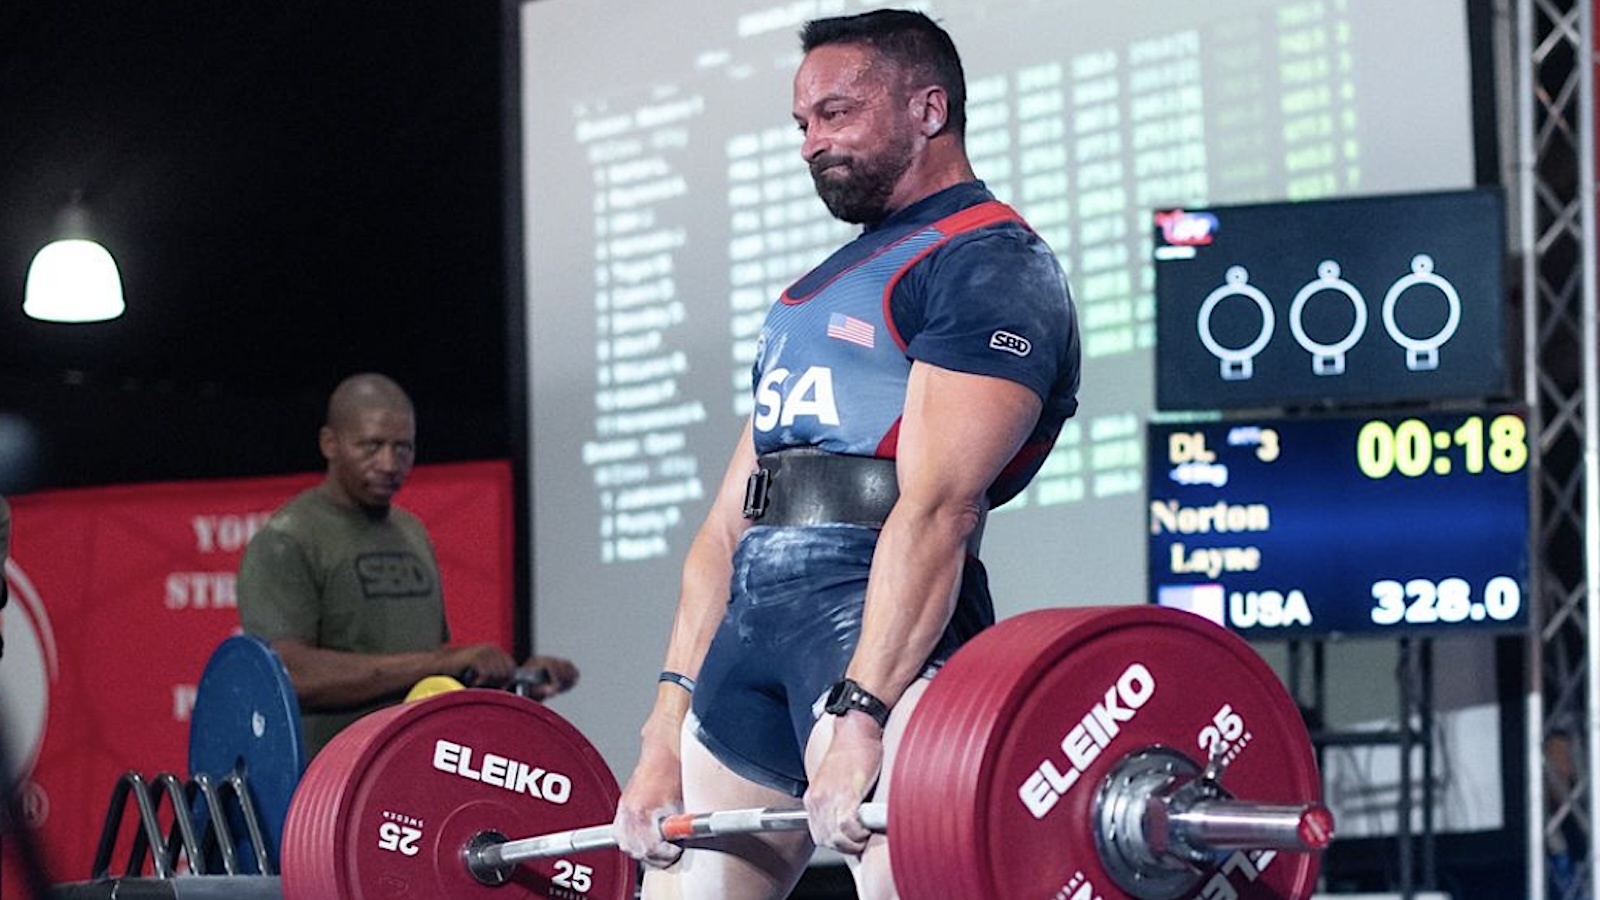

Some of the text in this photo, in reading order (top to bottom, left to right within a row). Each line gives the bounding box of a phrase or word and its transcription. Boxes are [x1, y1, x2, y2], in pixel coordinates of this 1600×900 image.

[991, 332, 1030, 355] SBD
[1169, 431, 1216, 464] DL
[1255, 428, 1280, 462] 3
[1357, 415, 1528, 479] 00:18
[1150, 500, 1270, 534] Norton
[1170, 543, 1261, 578] Layne
[1228, 590, 1312, 628] USA
[1371, 576, 1521, 625] 328.0
[1018, 663, 1155, 819] ELEIKO
[1198, 704, 1243, 761] 25
[433, 739, 572, 804] ELEIKO
[379, 821, 422, 856] 25
[551, 859, 593, 892] 25
